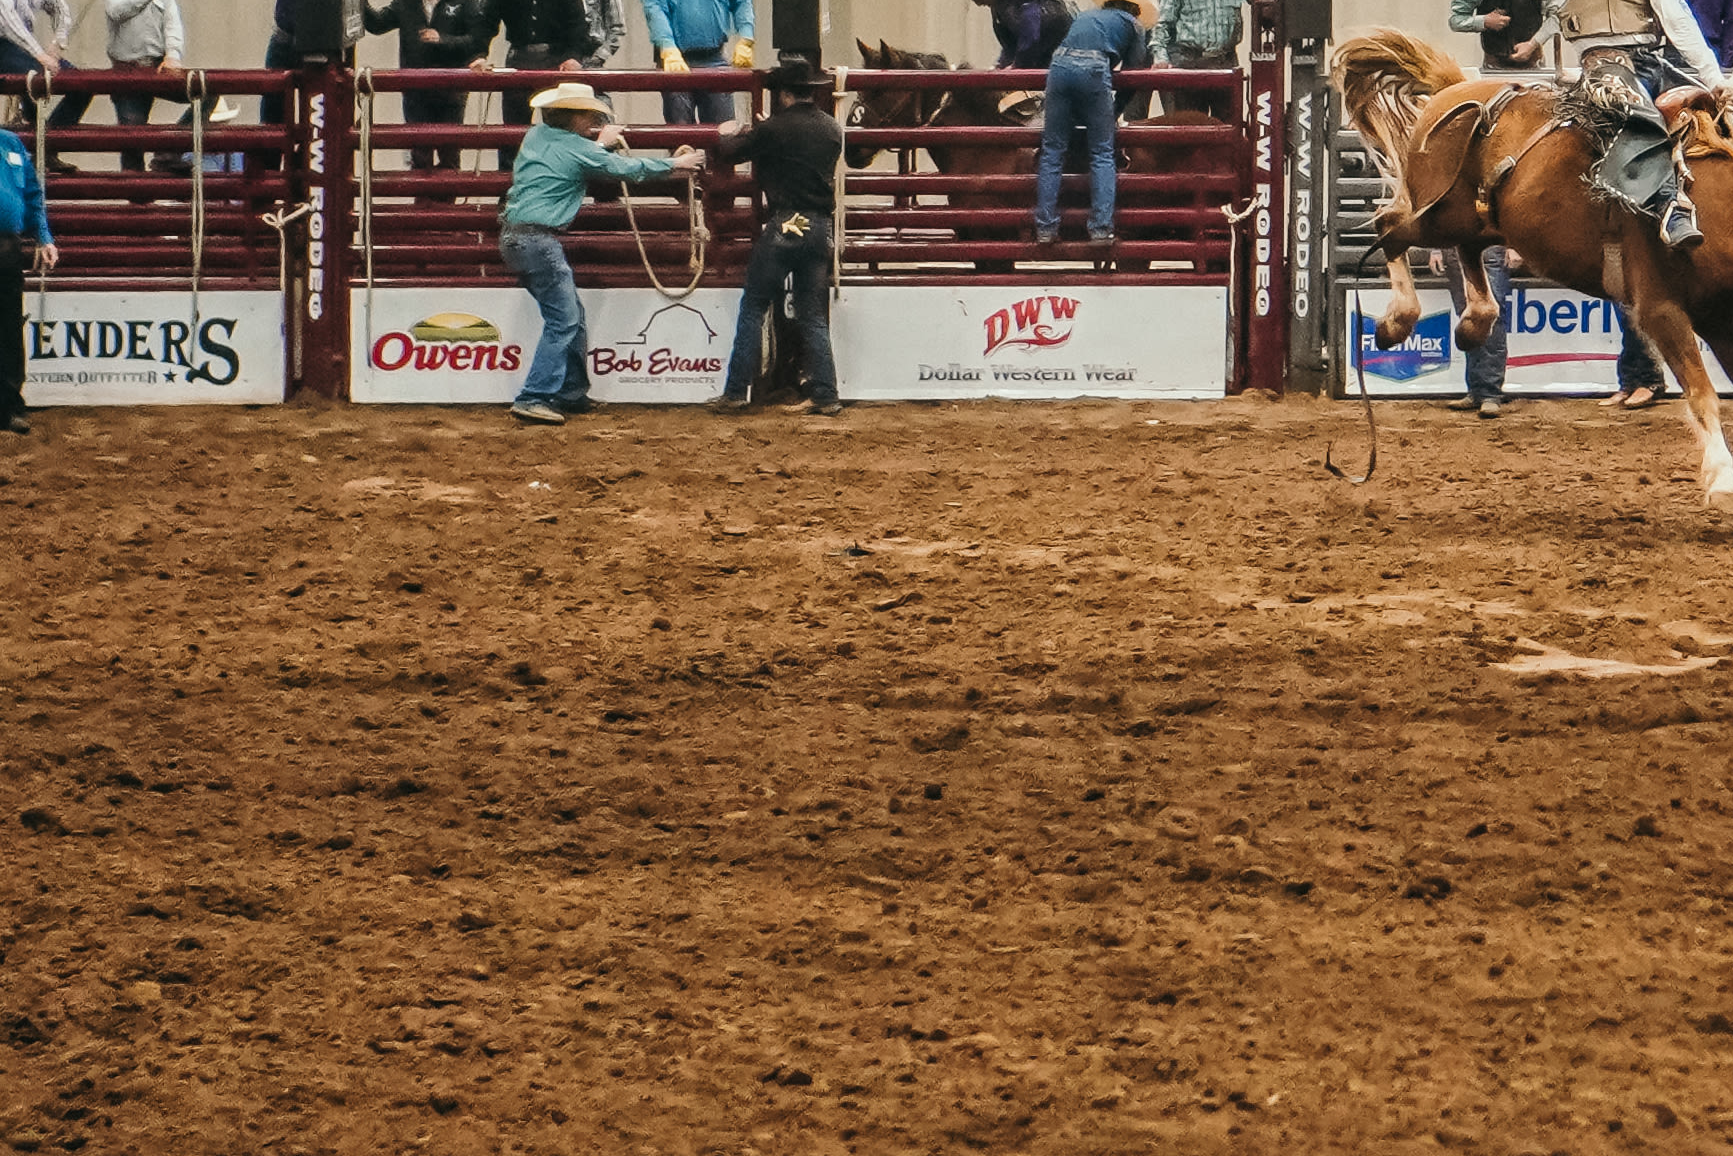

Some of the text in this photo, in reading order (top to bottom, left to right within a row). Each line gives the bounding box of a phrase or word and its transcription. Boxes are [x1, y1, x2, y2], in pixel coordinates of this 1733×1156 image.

[308, 186, 324, 321] RODEO
[1255, 183, 1271, 317] RODEO
[1295, 188, 1311, 318] RODEO
[372, 331, 522, 372] Owens
[983, 295, 1082, 356] DWW
[587, 347, 722, 375] Bob Evans
[918, 363, 1137, 381] Dollar Western Wear
